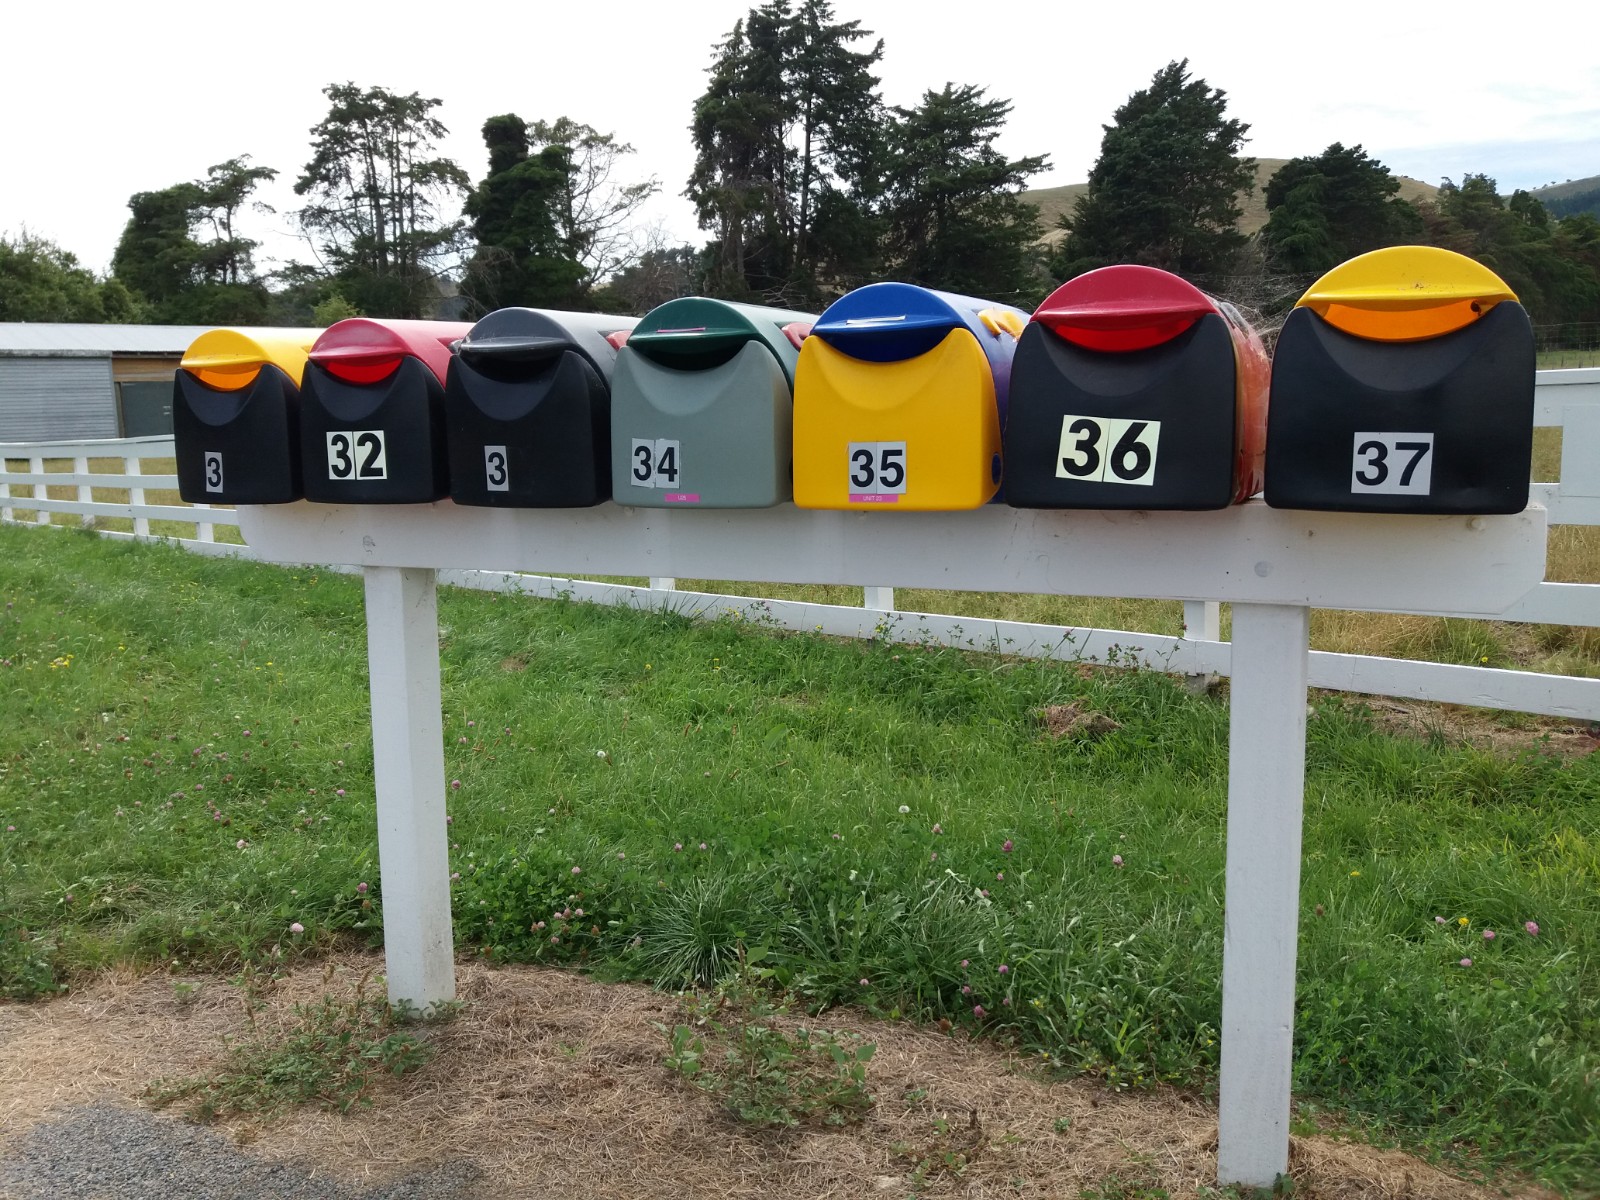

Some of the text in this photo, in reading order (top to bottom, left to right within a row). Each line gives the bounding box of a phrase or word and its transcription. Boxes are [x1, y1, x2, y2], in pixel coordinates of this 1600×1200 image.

[331, 434, 383, 477] 32
[634, 446, 678, 482] 34
[1063, 419, 1151, 480] 36
[1356, 441, 1430, 486] 37
[207, 457, 222, 487] 3
[488, 452, 506, 486] 3
[851, 450, 905, 487] 35
